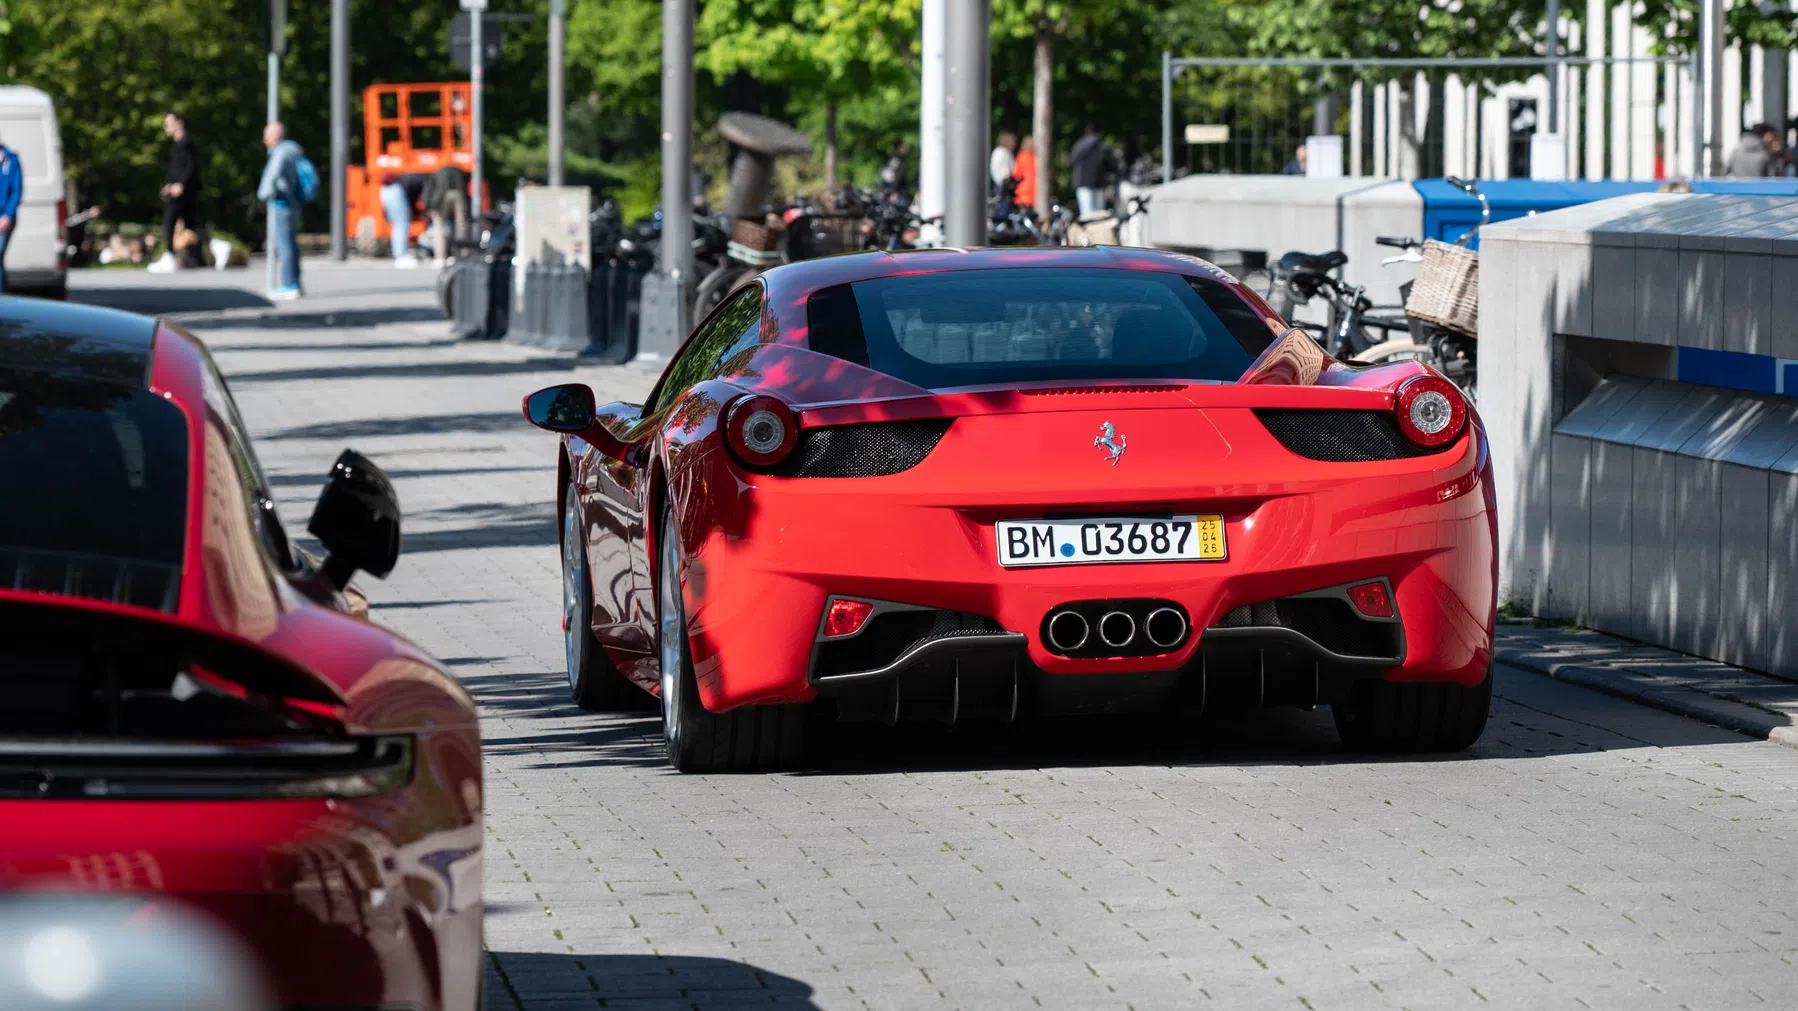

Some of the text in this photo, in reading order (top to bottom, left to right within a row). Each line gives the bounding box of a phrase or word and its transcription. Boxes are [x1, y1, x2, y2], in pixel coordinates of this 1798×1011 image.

[1201, 520, 1215, 530] 25
[1007, 521, 1192, 559] BM 03687
[1202, 532, 1216, 541] 04
[1203, 543, 1217, 553] 26
